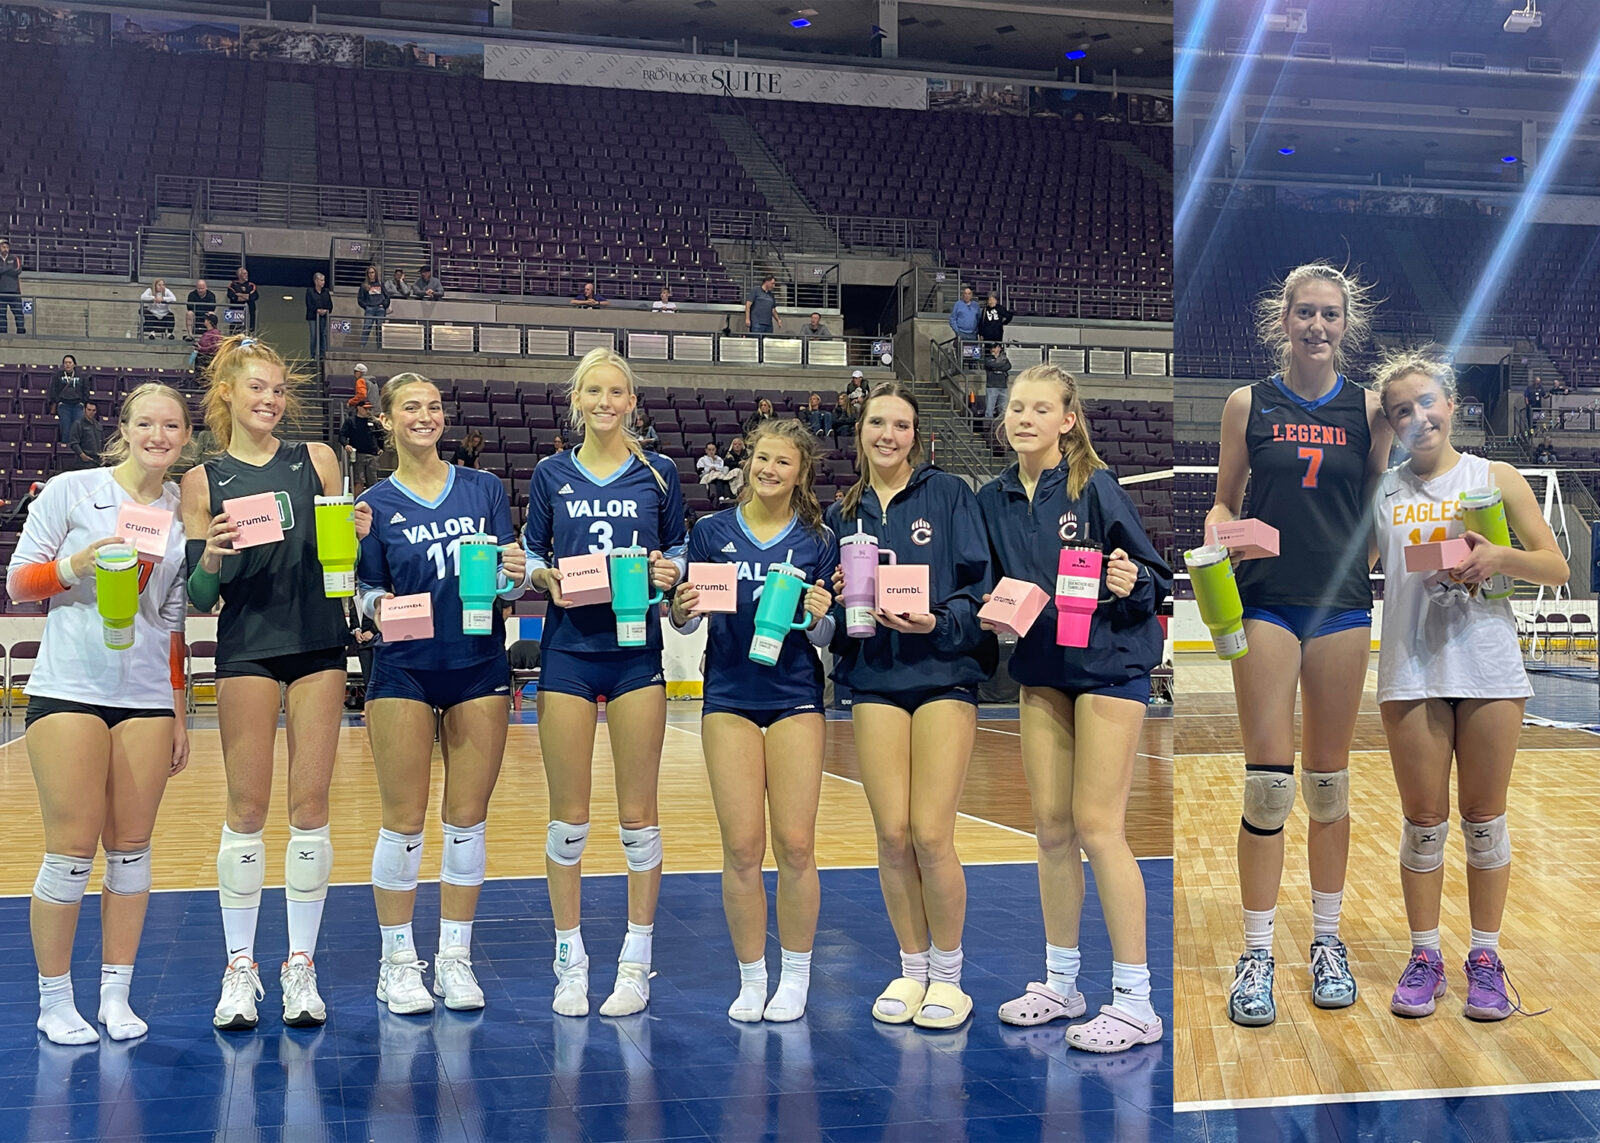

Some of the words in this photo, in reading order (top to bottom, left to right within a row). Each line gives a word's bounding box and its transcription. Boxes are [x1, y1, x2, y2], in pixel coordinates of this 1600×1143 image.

[711, 68, 782, 94] SUITE
[1272, 423, 1347, 446] LEGEND
[1297, 446, 1324, 489] 7
[566, 499, 638, 518] VALOR
[1393, 500, 1464, 526] EAGLES
[402, 516, 477, 545] VALOR
[588, 520, 613, 557] 3
[426, 538, 460, 580] 11
